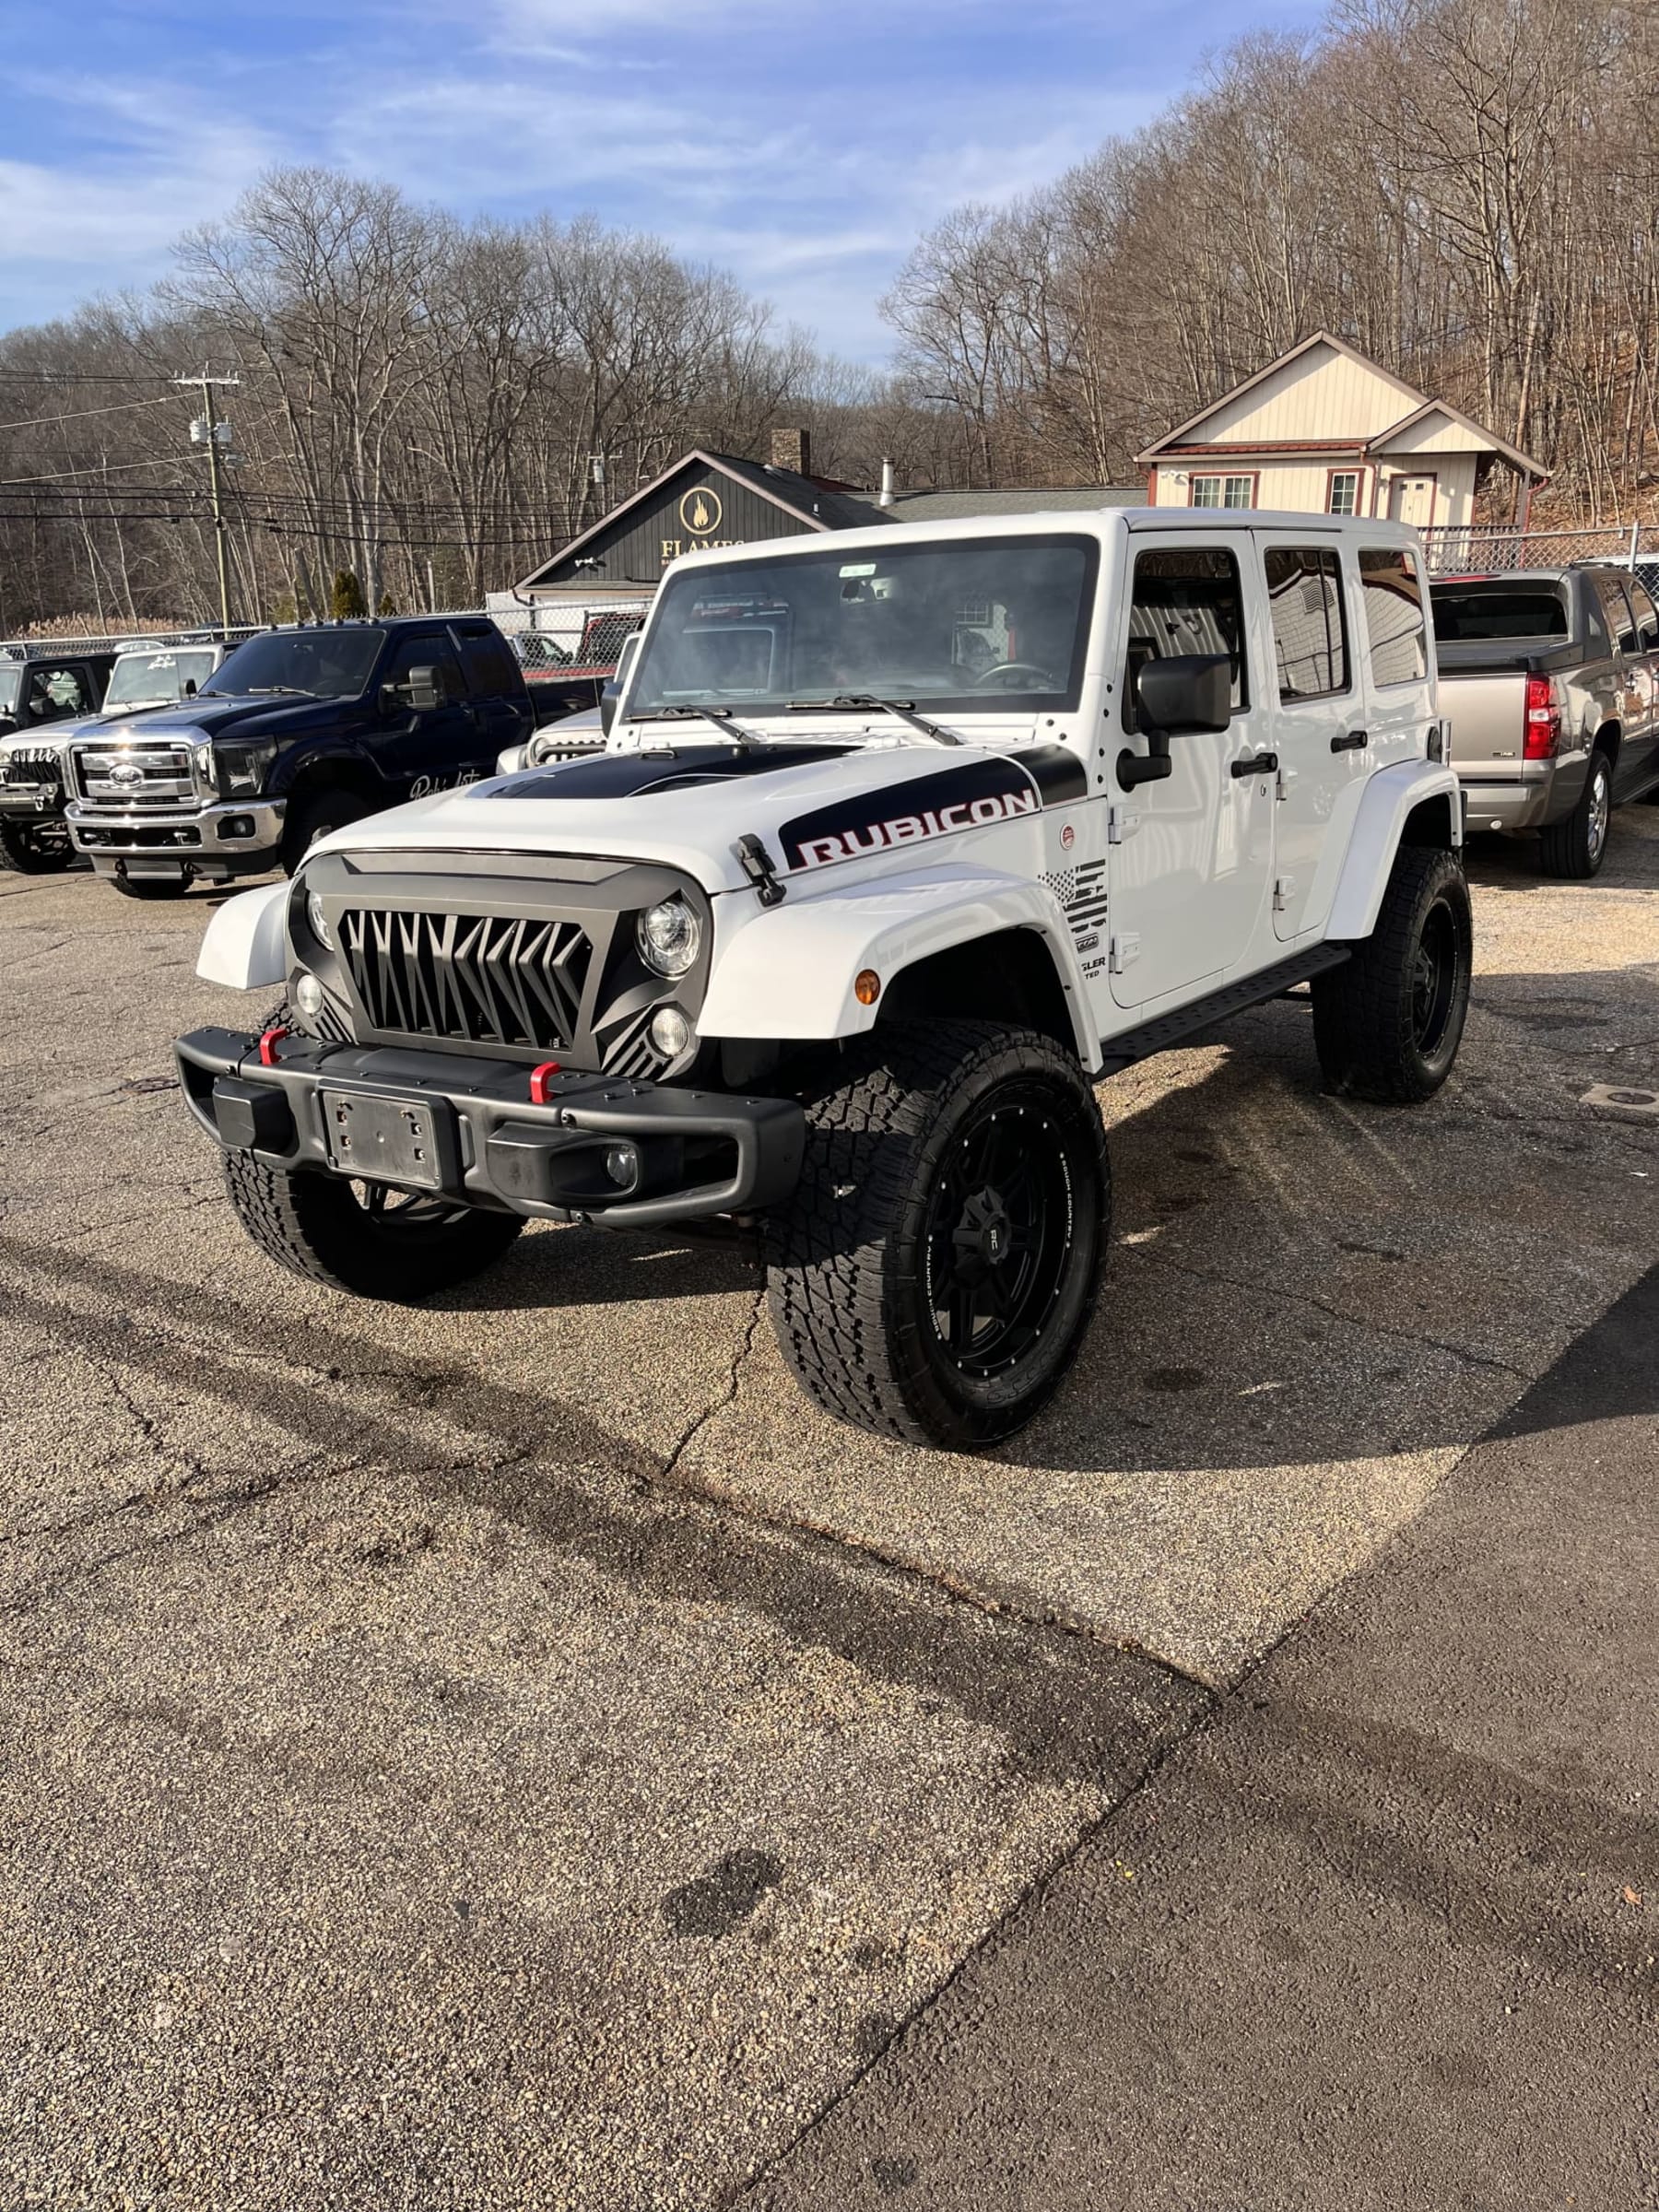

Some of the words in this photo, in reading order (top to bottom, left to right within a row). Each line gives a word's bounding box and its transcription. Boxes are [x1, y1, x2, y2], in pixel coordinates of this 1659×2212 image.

[661, 540, 745, 558] FLAM
[796, 788, 1038, 868] RUBICON
[990, 1229, 998, 1251] RC
